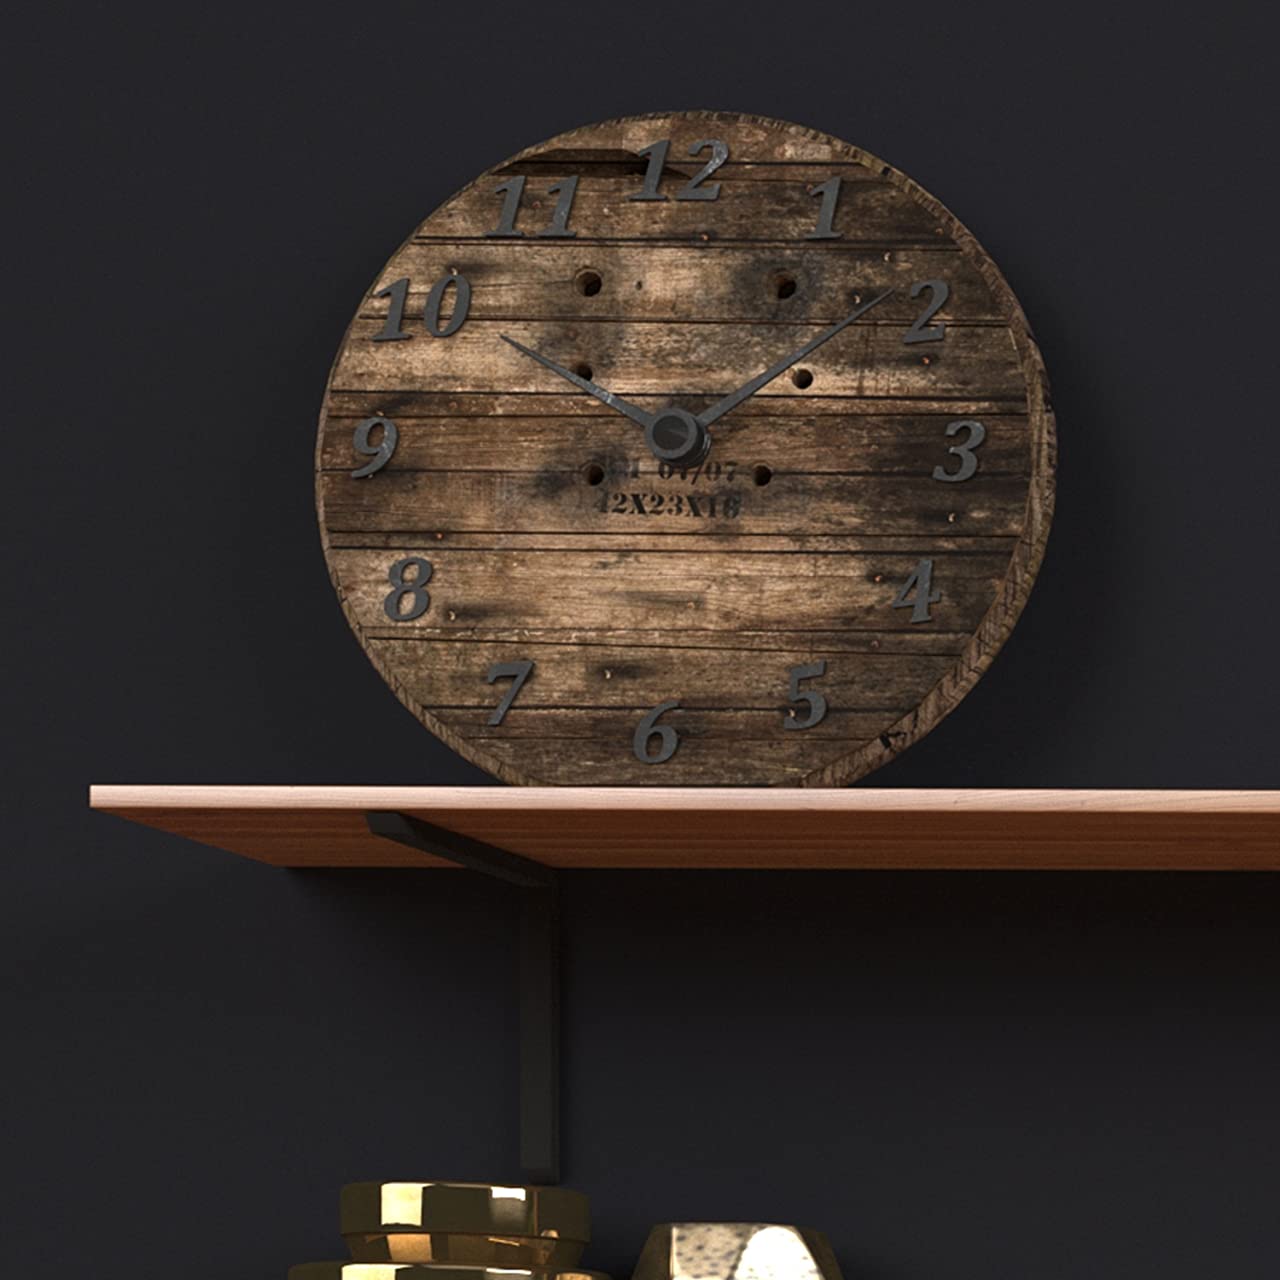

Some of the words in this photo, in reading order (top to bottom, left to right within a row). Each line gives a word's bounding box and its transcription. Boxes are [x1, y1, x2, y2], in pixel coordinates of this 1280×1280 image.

[629, 139, 730, 201] 12
[484, 175, 580, 239] 11
[806, 177, 843, 240] 1
[372, 272, 471, 342] 10
[903, 278, 951, 343] 2
[351, 417, 398, 479] 9
[932, 421, 987, 483] 3
[383, 557, 432, 622] 8
[892, 560, 942, 624] 4
[486, 660, 534, 727] 7
[782, 661, 827, 730] 5
[632, 701, 682, 765] 6
